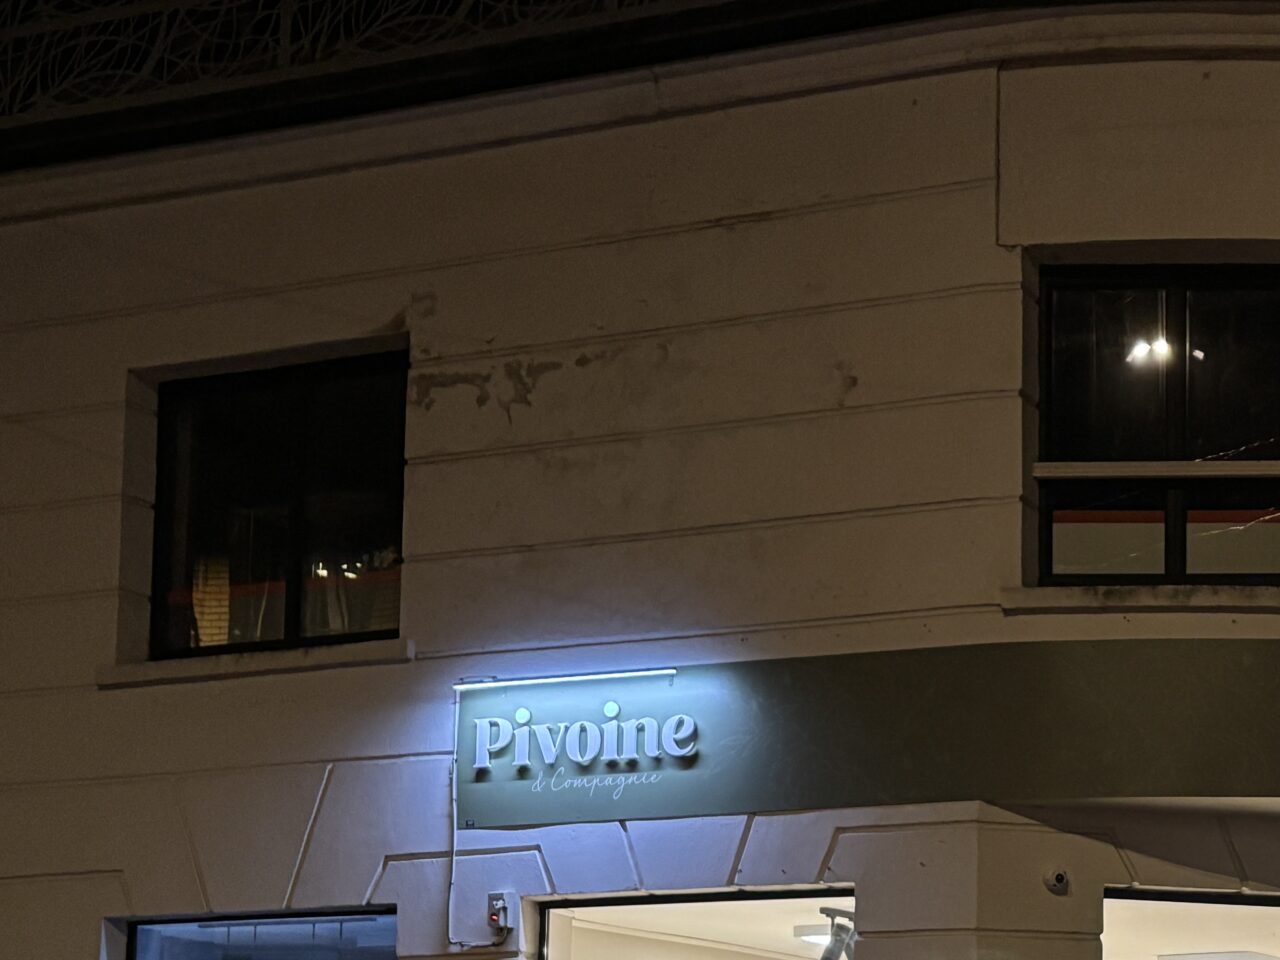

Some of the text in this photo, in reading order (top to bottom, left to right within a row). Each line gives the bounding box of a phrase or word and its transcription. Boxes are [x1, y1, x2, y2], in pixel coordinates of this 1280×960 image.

[473, 700, 698, 768] Pivoine
[531, 767, 664, 799] & Compagnie
